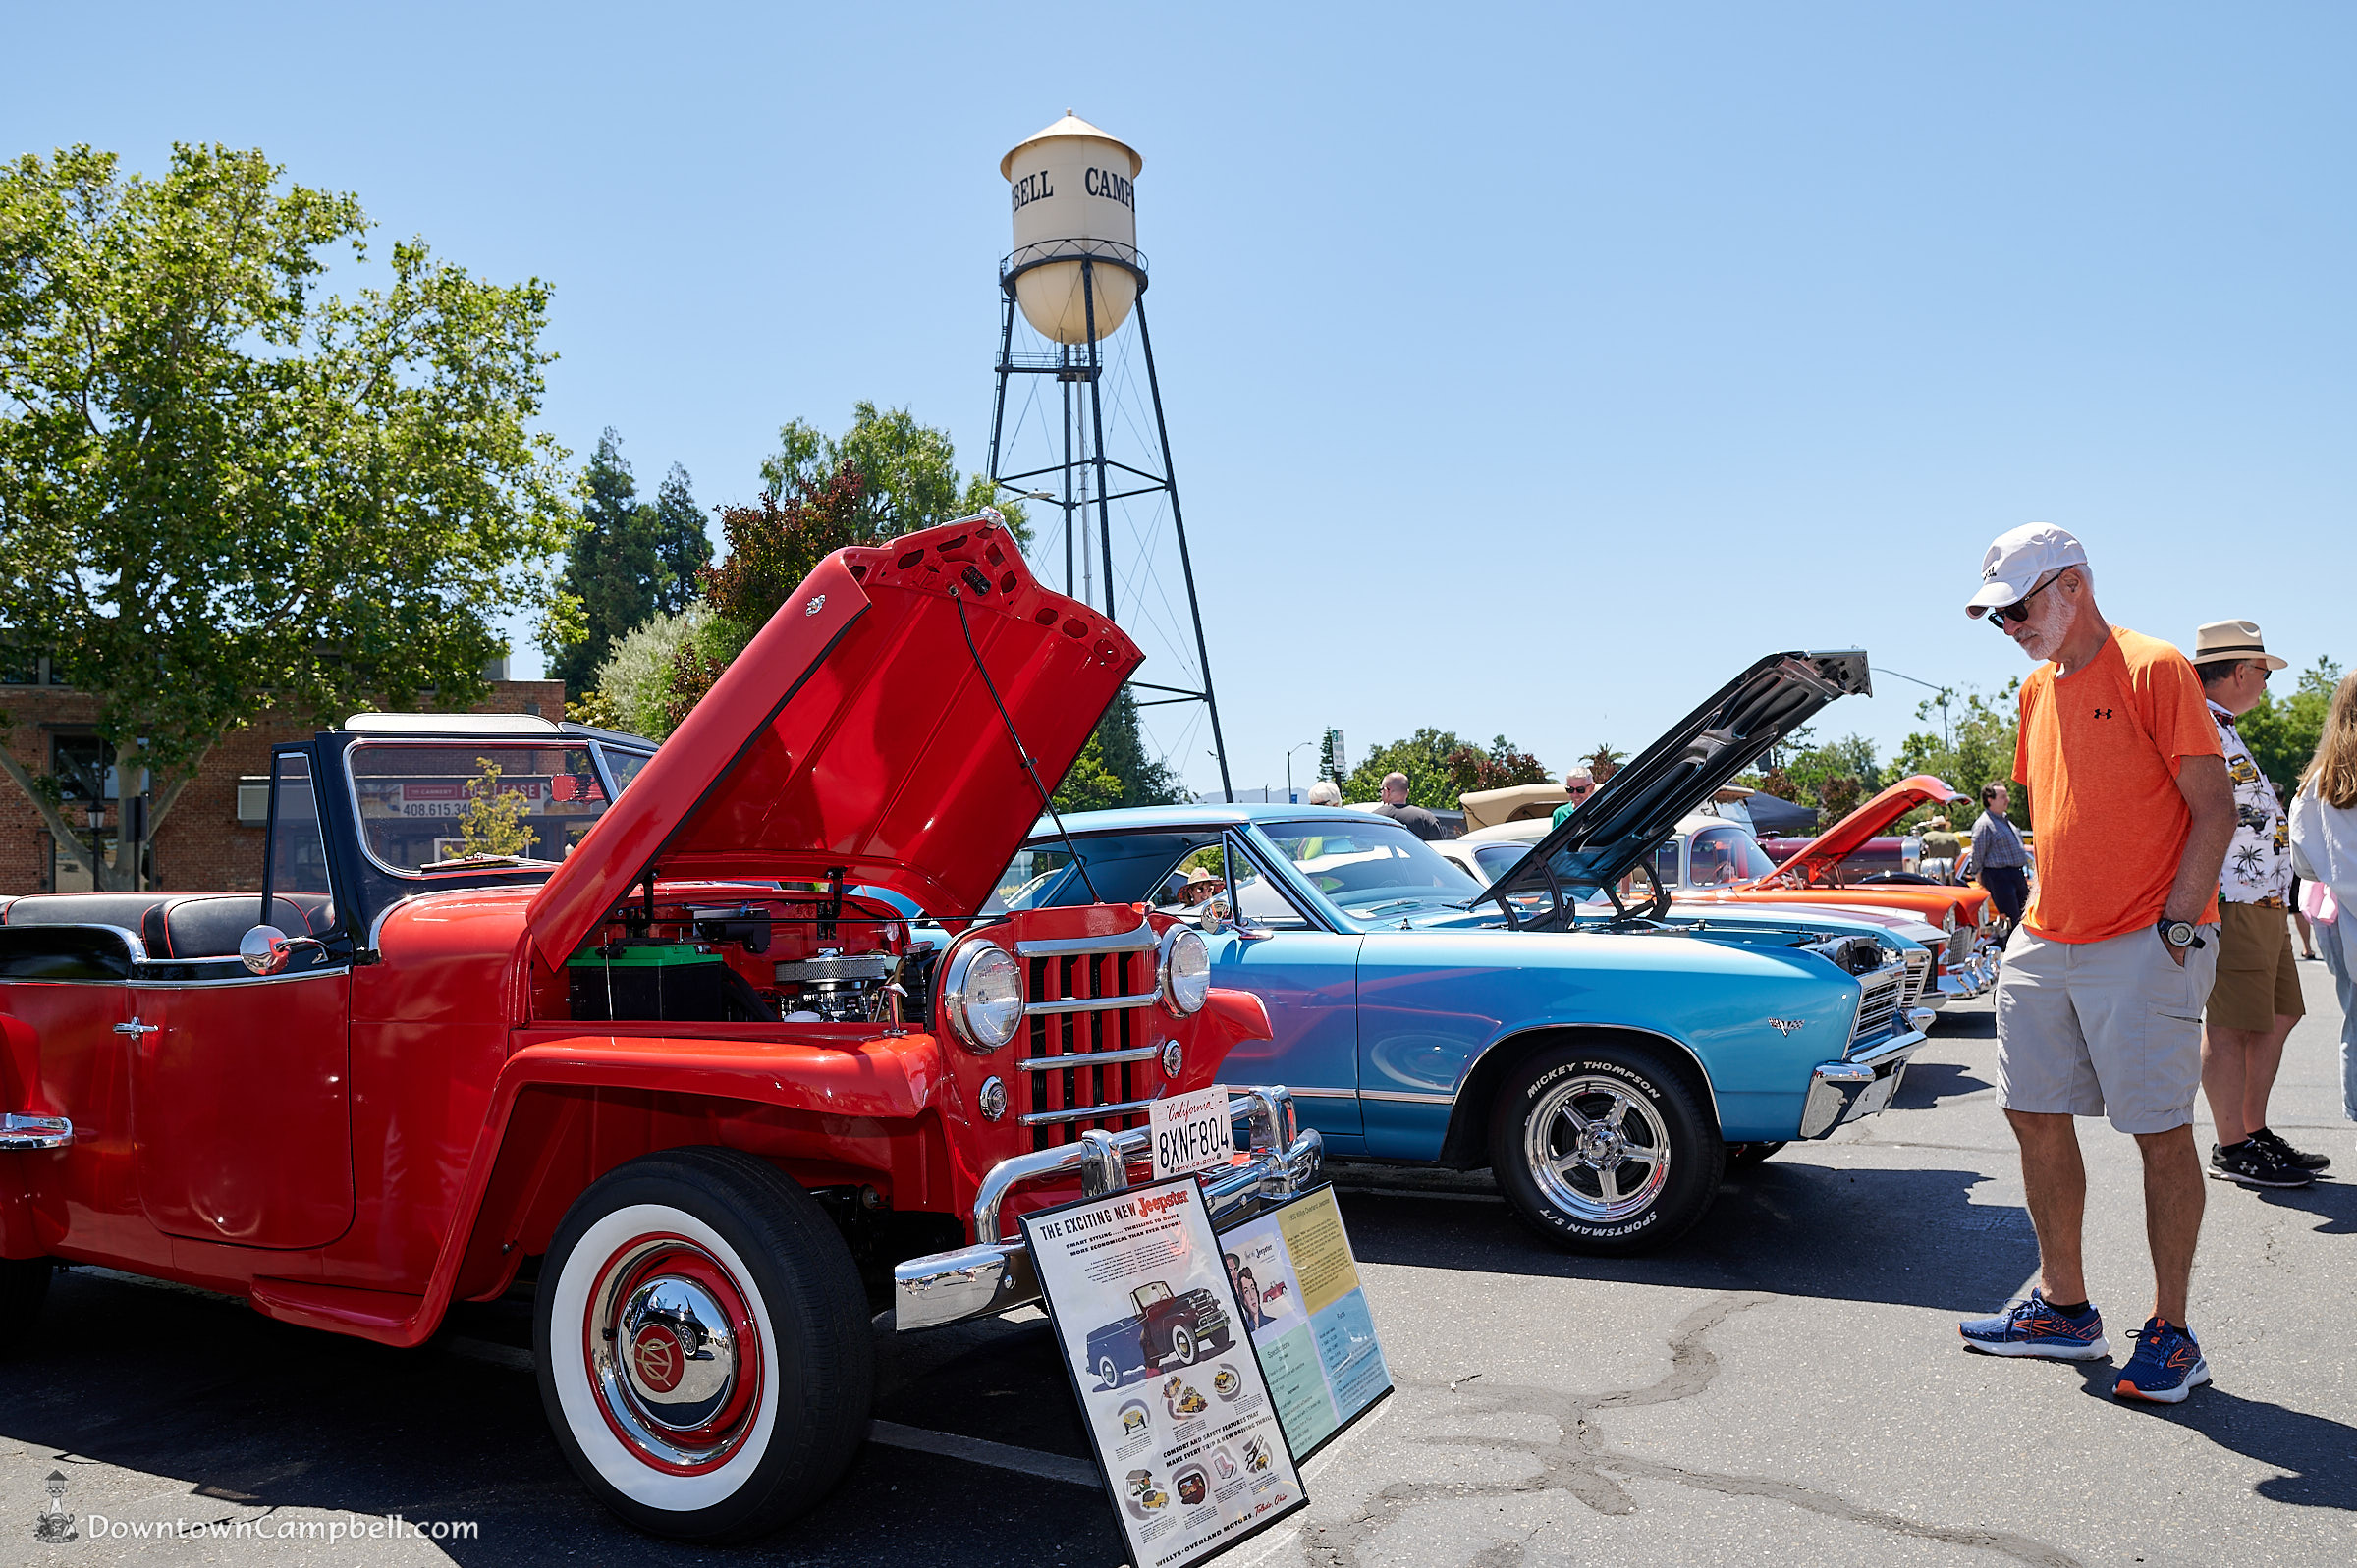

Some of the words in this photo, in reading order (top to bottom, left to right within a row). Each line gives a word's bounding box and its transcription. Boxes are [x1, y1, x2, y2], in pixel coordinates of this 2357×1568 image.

[1013, 170, 1054, 212] BELL
[1526, 1062, 1576, 1099] MICKEY
[1583, 1061, 1661, 1099] THOMPSON
[1169, 1097, 1216, 1122] California
[1159, 1115, 1229, 1169] 8XNF804
[1175, 1157, 1216, 1173] dmv.ca.gov
[1039, 1222, 1063, 1241] THE
[1064, 1210, 1112, 1234] EXCITING
[1114, 1202, 1137, 1220] NEW
[1138, 1189, 1190, 1217] Jeepster
[1539, 1207, 1565, 1225] S/T
[1566, 1210, 1658, 1237] SPORTSMAN
[1066, 1239, 1088, 1249] SMART
[1124, 1221, 1153, 1232] THRILLING
[1070, 1247, 1088, 1257] MORE
[1090, 1236, 1127, 1251] ECONOMICAL
[1129, 1231, 1143, 1240] THAN
[1161, 1221, 1182, 1231] BEFORE
[1163, 1442, 1190, 1459] COMFORT
[1203, 1429, 1222, 1441] SAFETY
[1222, 1416, 1247, 1432] FEATURES
[1247, 1411, 1259, 1420] THAT
[1165, 1457, 1183, 1468] MAKE
[1184, 1447, 1200, 1459] EVERY
[1202, 1441, 1216, 1451] TRIP
[1222, 1433, 1233, 1442] NEW
[1233, 1422, 1255, 1437] DRIVING
[1255, 1415, 1273, 1426] THRILL
